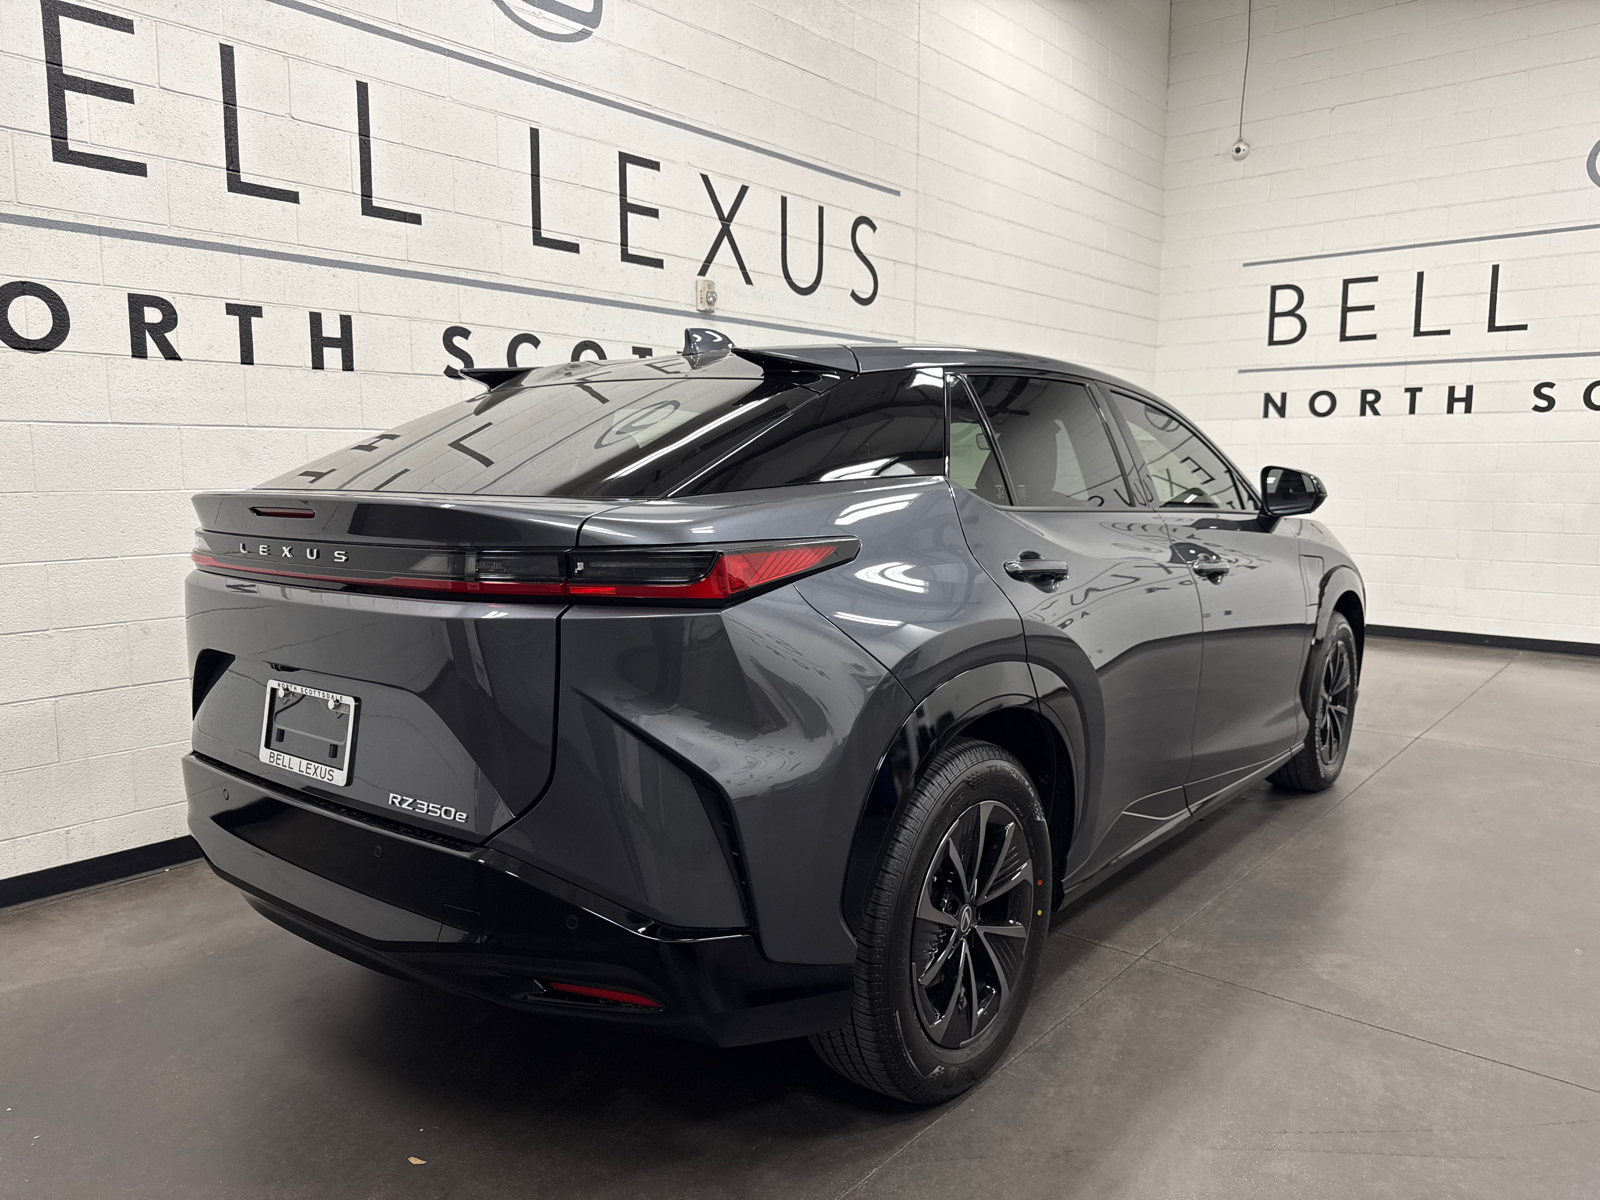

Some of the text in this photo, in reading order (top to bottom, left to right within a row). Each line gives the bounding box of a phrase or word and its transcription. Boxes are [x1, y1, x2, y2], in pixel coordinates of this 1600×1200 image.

[529, 126, 879, 306] LEXUS
[1267, 263, 1528, 347] BELL
[0, 281, 355, 372] ORTH
[1262, 384, 1474, 419] NORTH
[239, 542, 349, 563] LEXUS
[277, 682, 343, 702] NORTH SCOTTSDALE
[268, 751, 335, 782] BELL LEXUS
[388, 792, 468, 823] RZ350e
